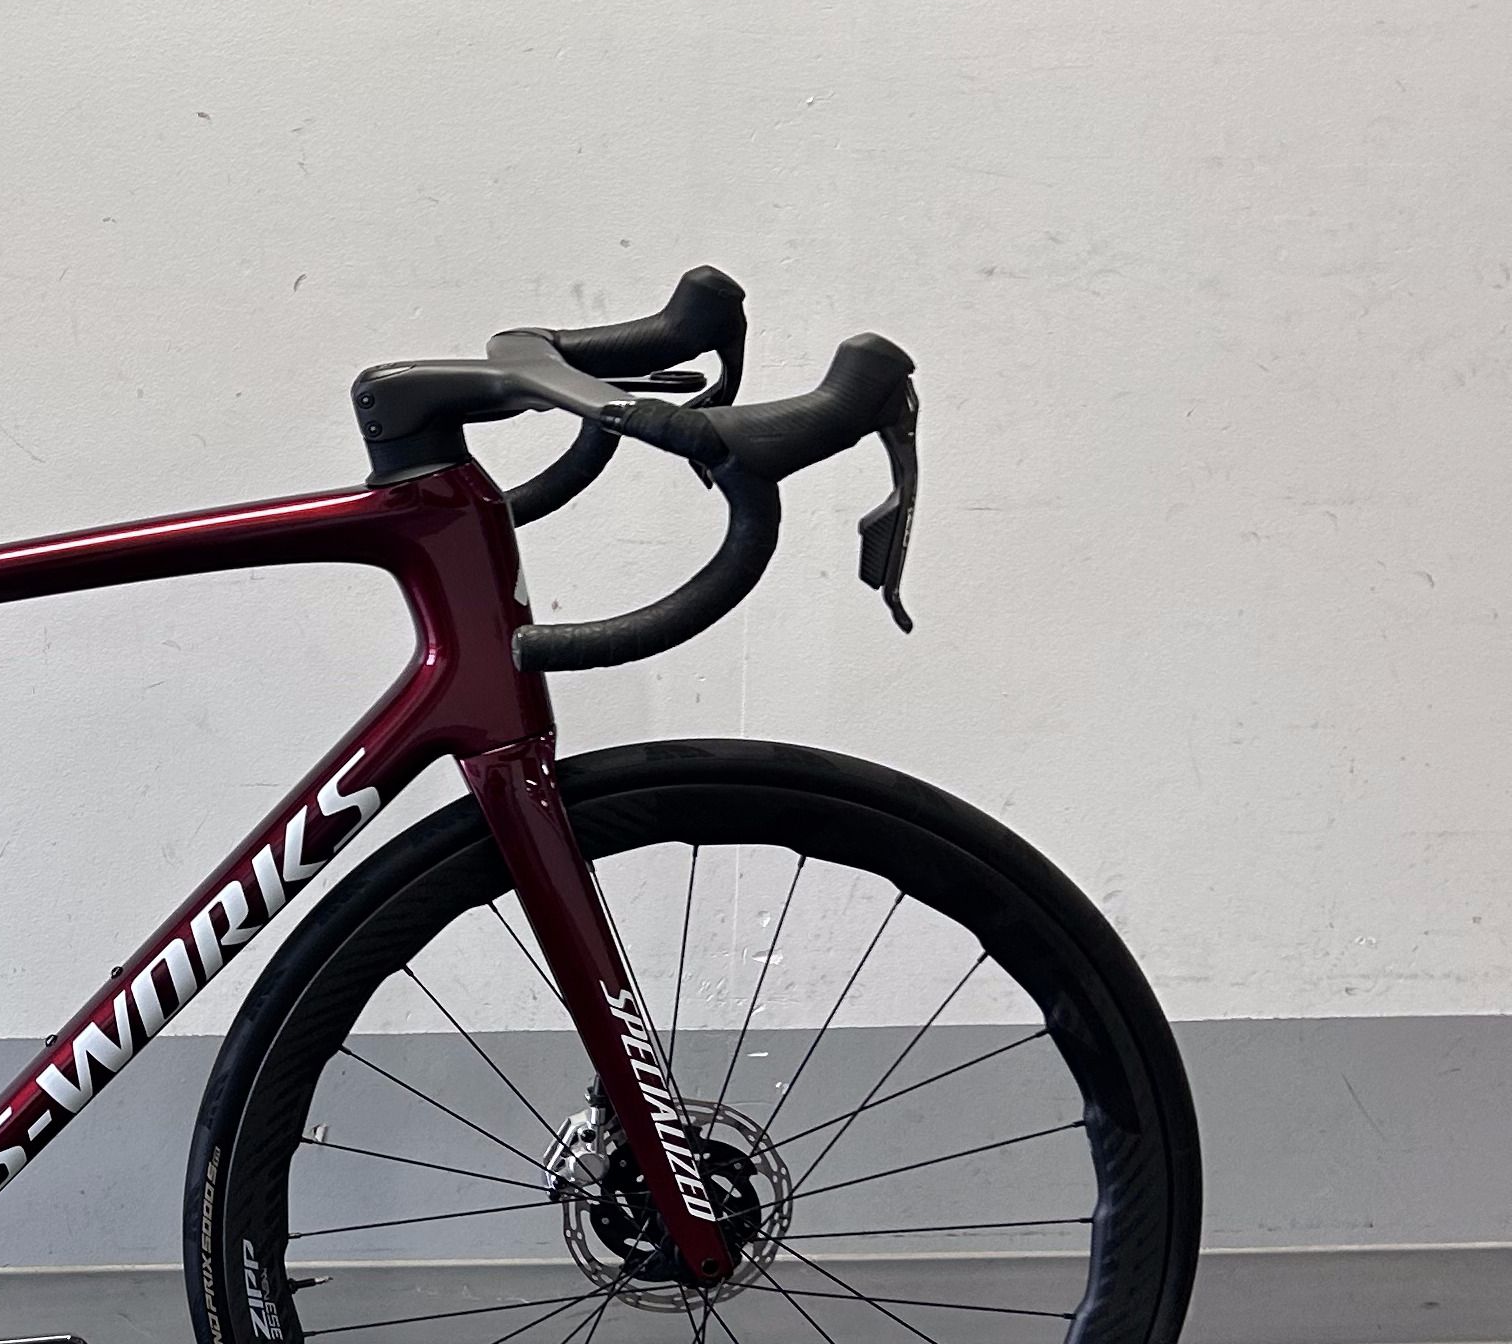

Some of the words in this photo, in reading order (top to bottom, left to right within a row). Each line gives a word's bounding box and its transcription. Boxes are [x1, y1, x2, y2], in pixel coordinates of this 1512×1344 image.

[599, 979, 717, 1222] SPECIALIZED
[201, 1181, 215, 1254] 5000
[202, 1252, 217, 1313] PRIX
[242, 1238, 271, 1340] ZIPP
